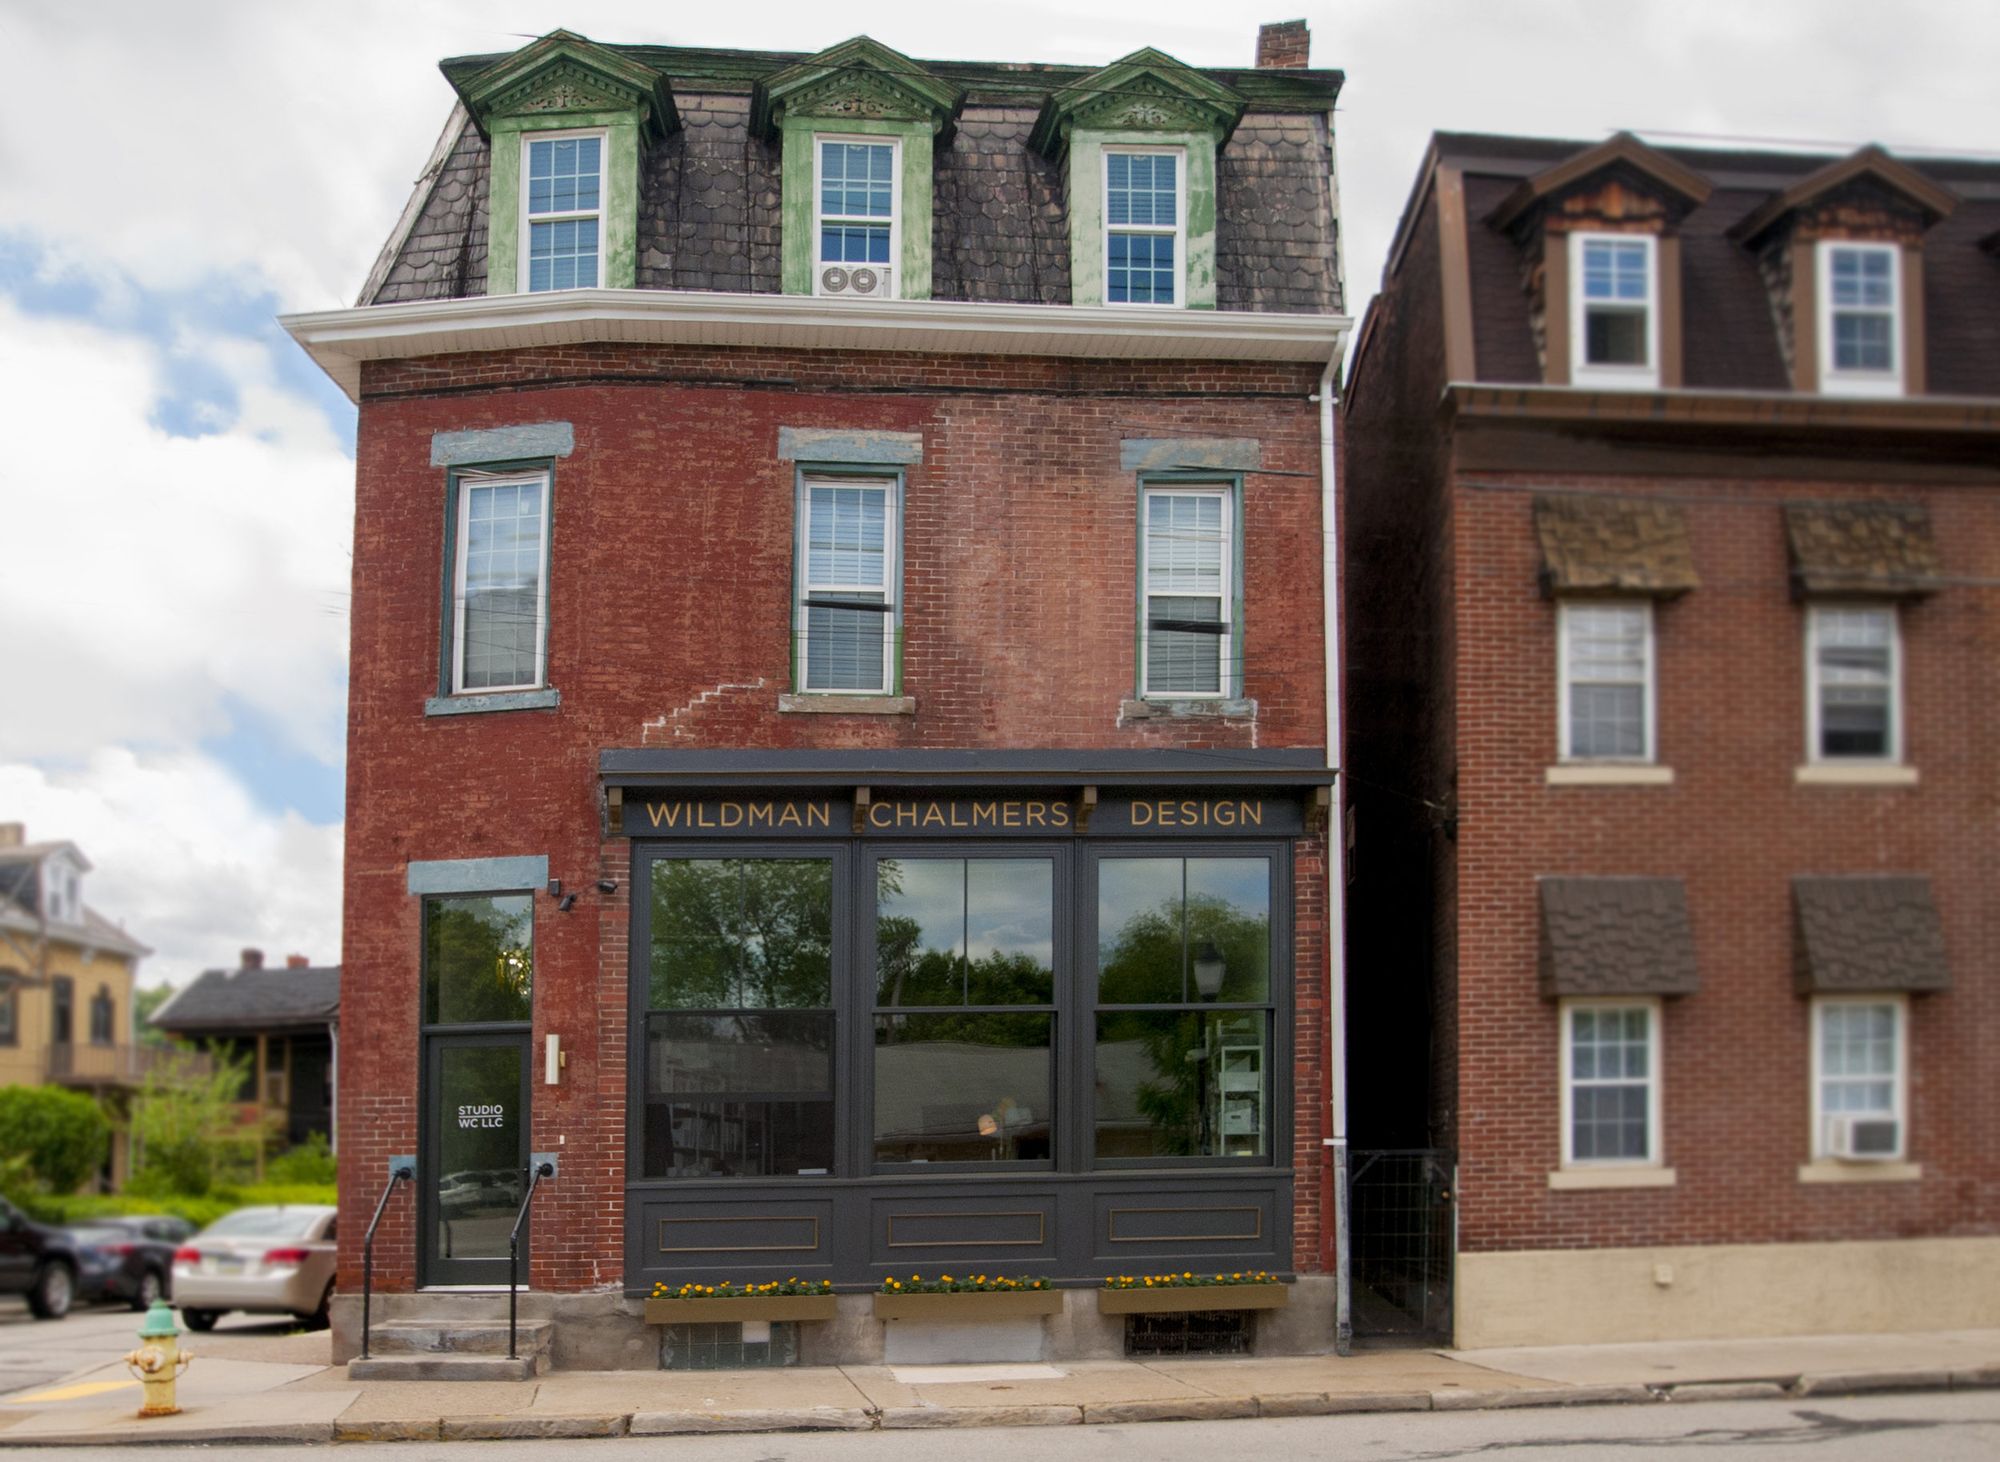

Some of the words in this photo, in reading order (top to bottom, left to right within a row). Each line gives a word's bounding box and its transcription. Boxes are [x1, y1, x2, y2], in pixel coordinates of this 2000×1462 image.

[646, 802, 830, 828] WILDMAN
[869, 801, 1070, 828] CHALMERS
[1131, 800, 1262, 826] DESIGN
[458, 1104, 504, 1115] STUDIO
[458, 1118, 479, 1129] WC
[481, 1117, 504, 1128] LLC
